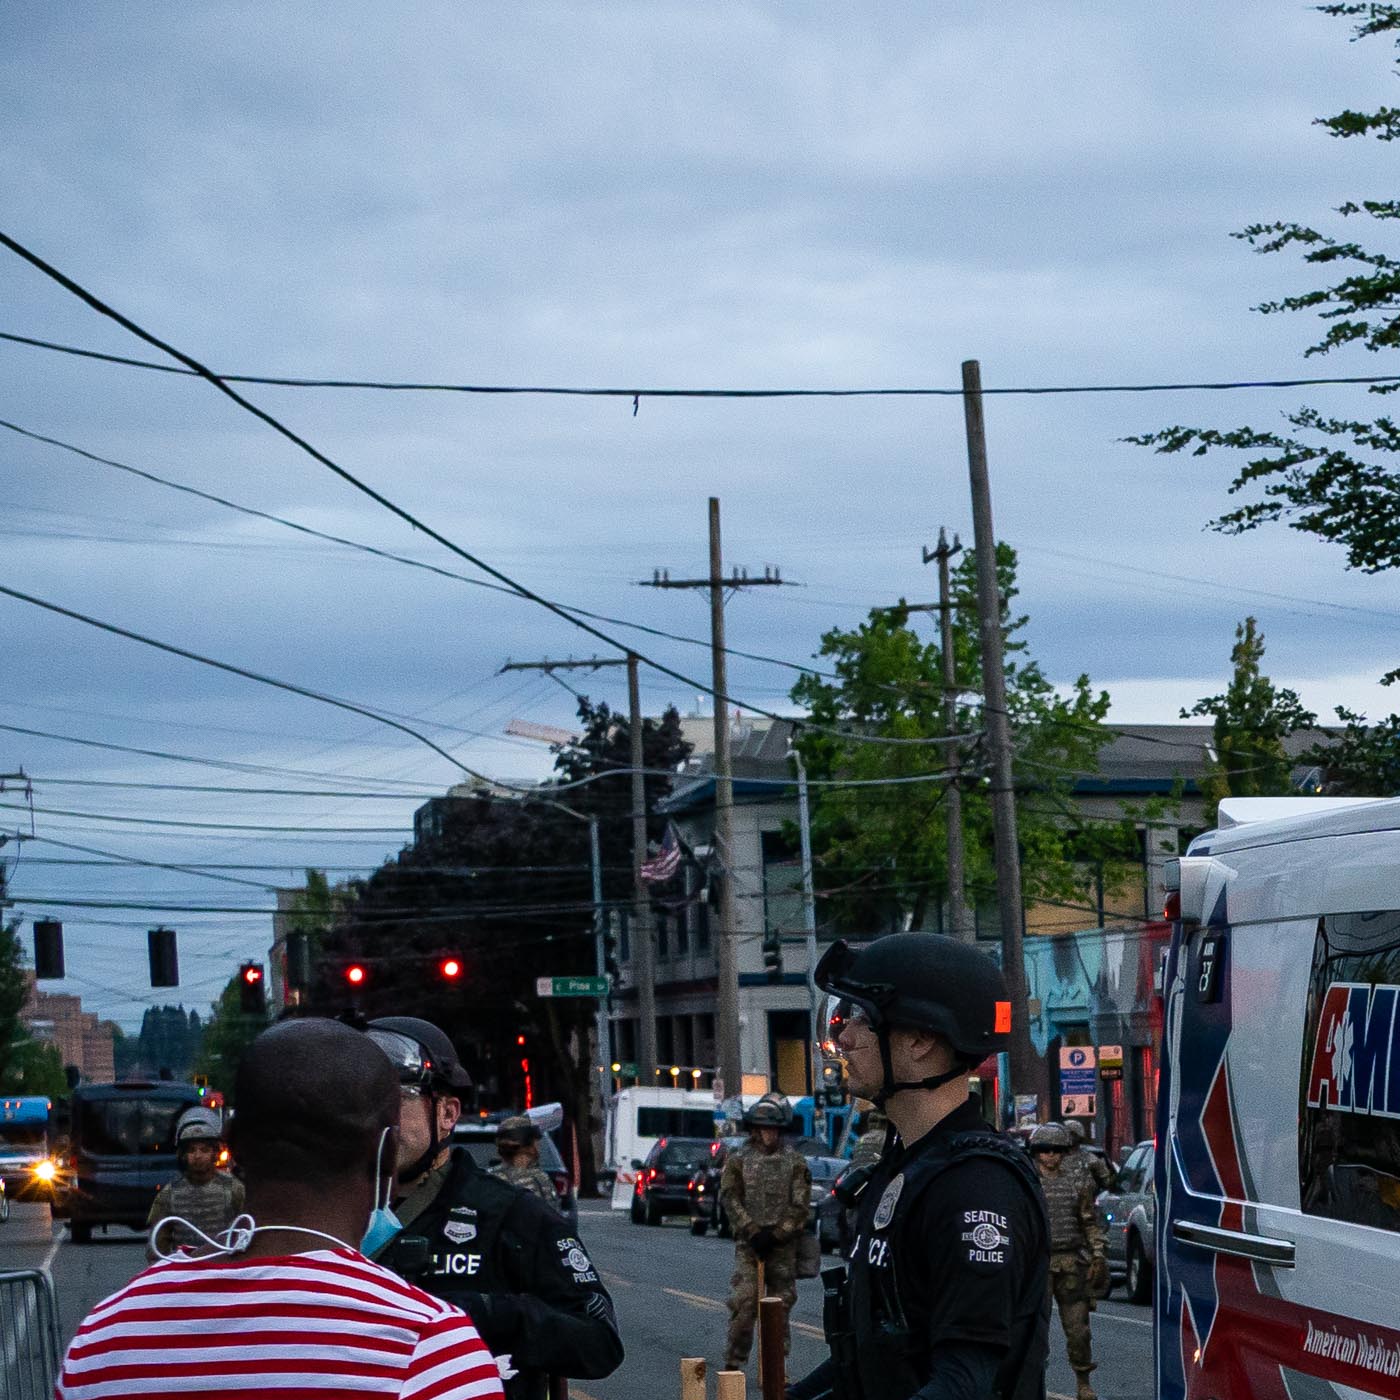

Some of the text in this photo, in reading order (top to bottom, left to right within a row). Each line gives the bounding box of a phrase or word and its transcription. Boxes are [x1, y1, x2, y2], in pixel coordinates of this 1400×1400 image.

[963, 1209, 1008, 1229] SEATTLE
[969, 1249, 1005, 1263] POLICE
[573, 1271, 598, 1283] POLICE
[1303, 1319, 1357, 1364] American
